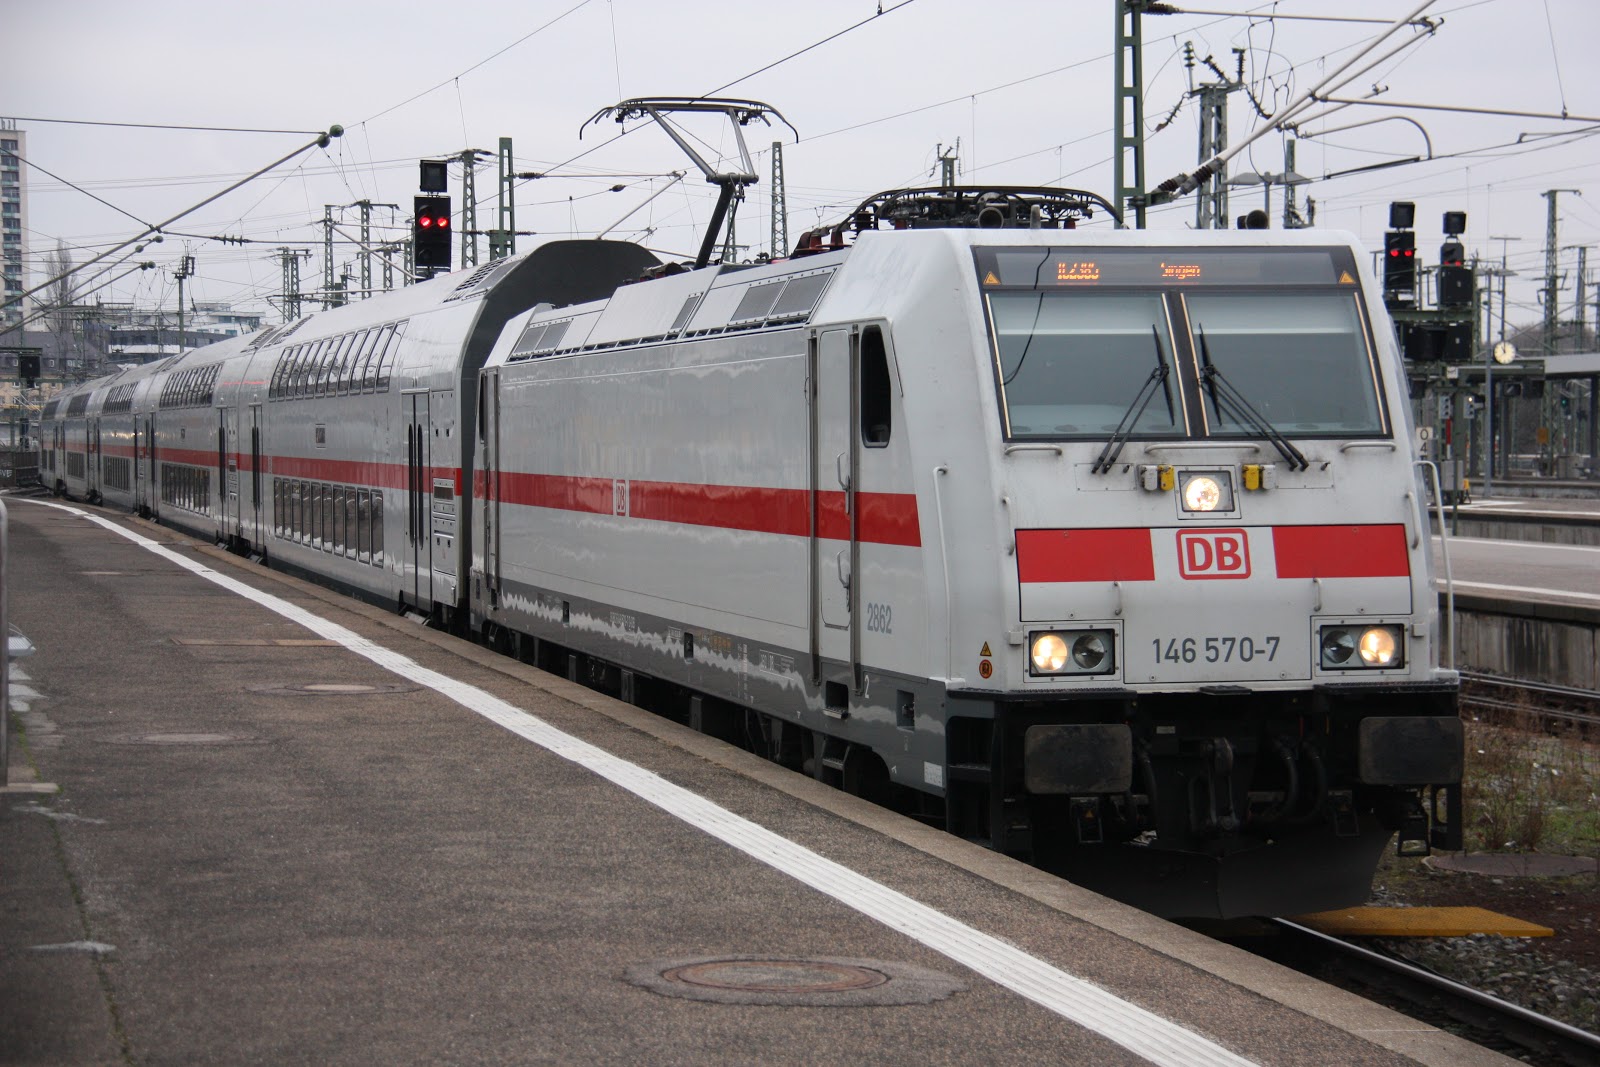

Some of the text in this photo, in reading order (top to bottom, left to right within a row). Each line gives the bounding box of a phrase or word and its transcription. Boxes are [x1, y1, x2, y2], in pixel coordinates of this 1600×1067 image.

[1183, 535, 1244, 573] DB
[867, 602, 892, 634] 2862
[1152, 636, 1280, 664] 146 570-7
[864, 674, 870, 699] 2
